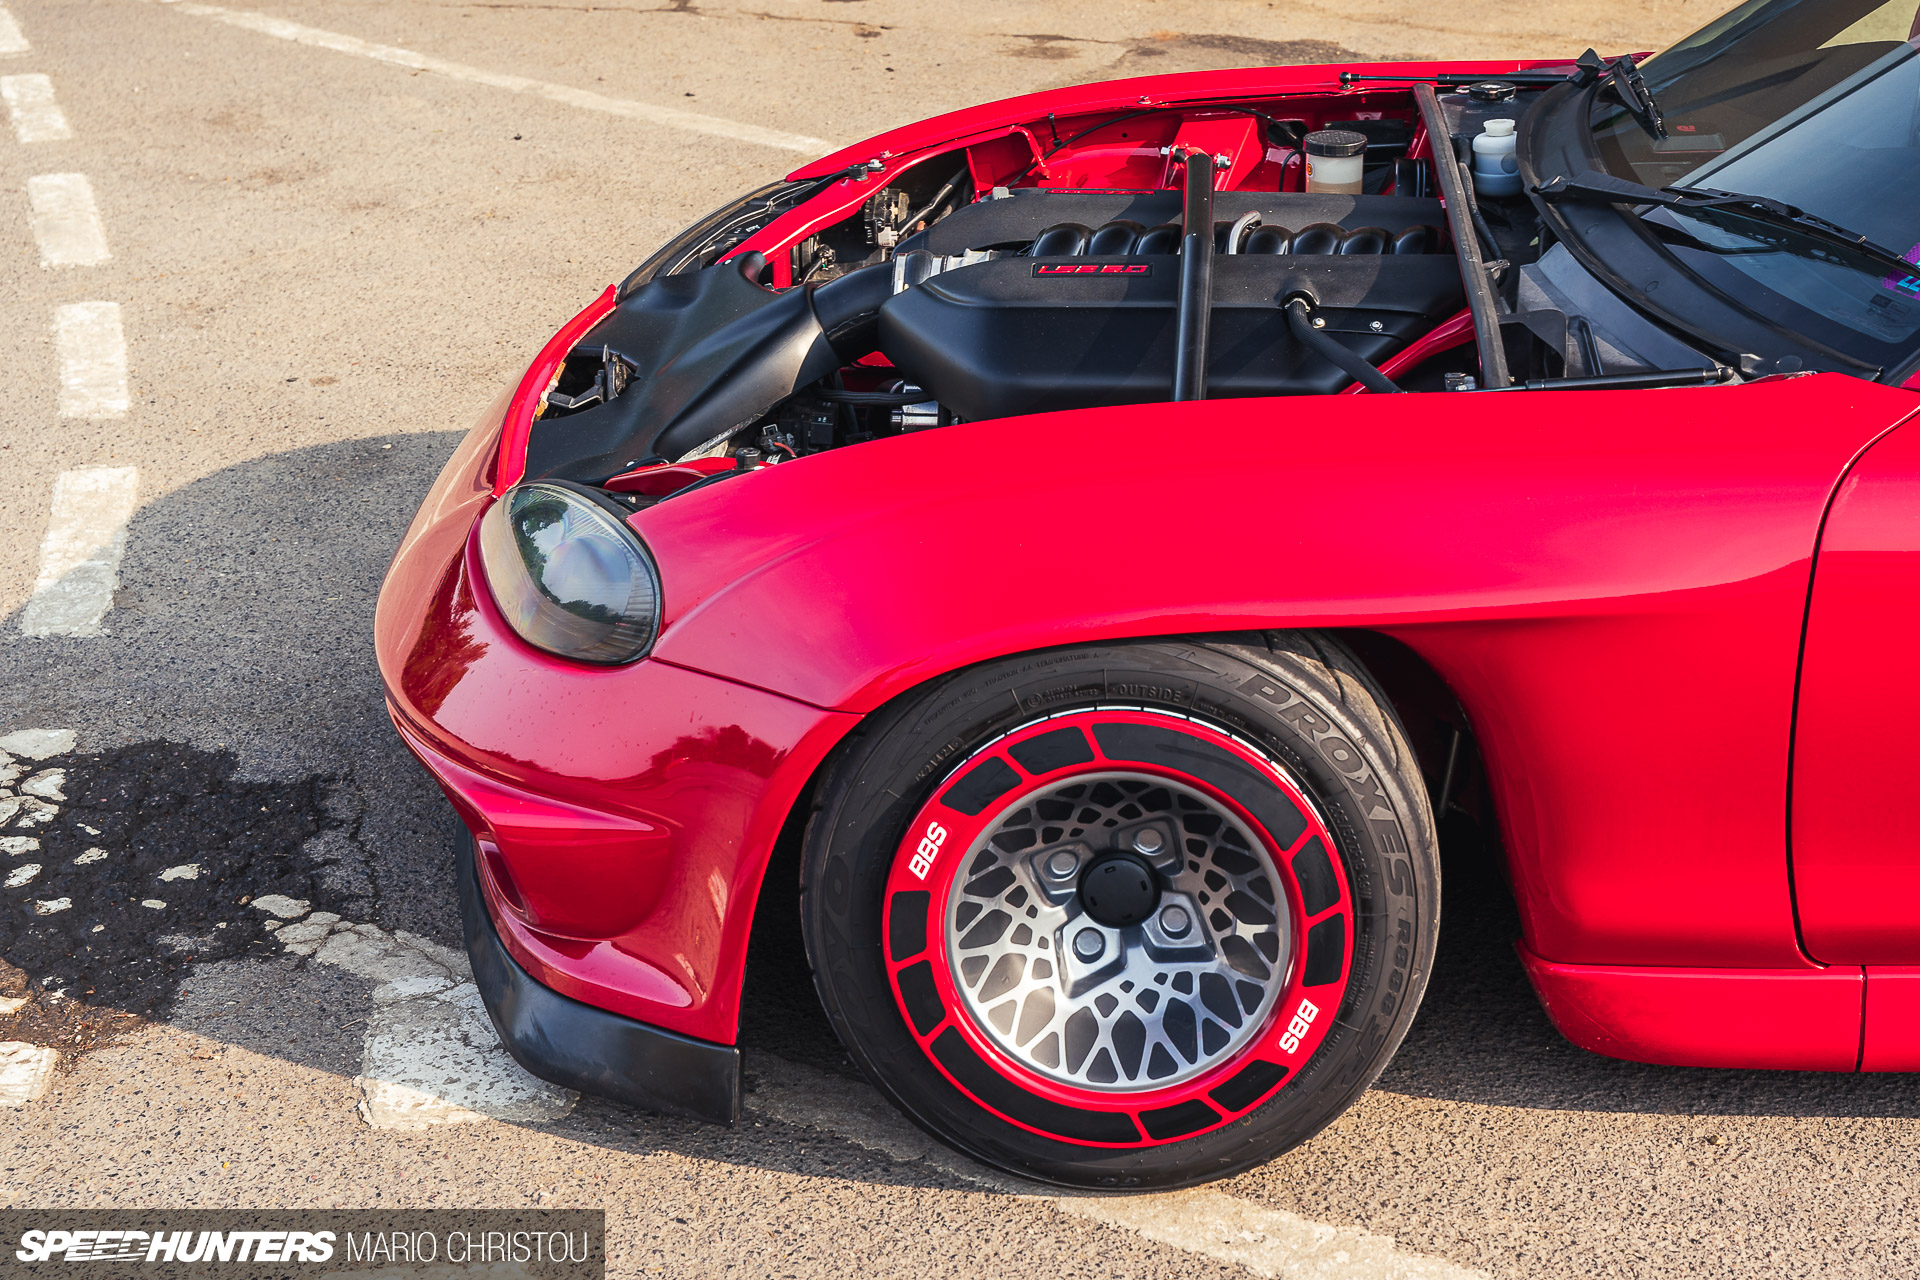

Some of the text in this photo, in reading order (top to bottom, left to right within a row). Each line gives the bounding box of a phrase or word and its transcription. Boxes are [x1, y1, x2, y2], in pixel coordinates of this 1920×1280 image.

[1118, 683, 1182, 703] OUTSIDE
[1236, 673, 1414, 897] PROXES
[908, 821, 947, 881] BBS
[1279, 998, 1319, 1055] BBS
